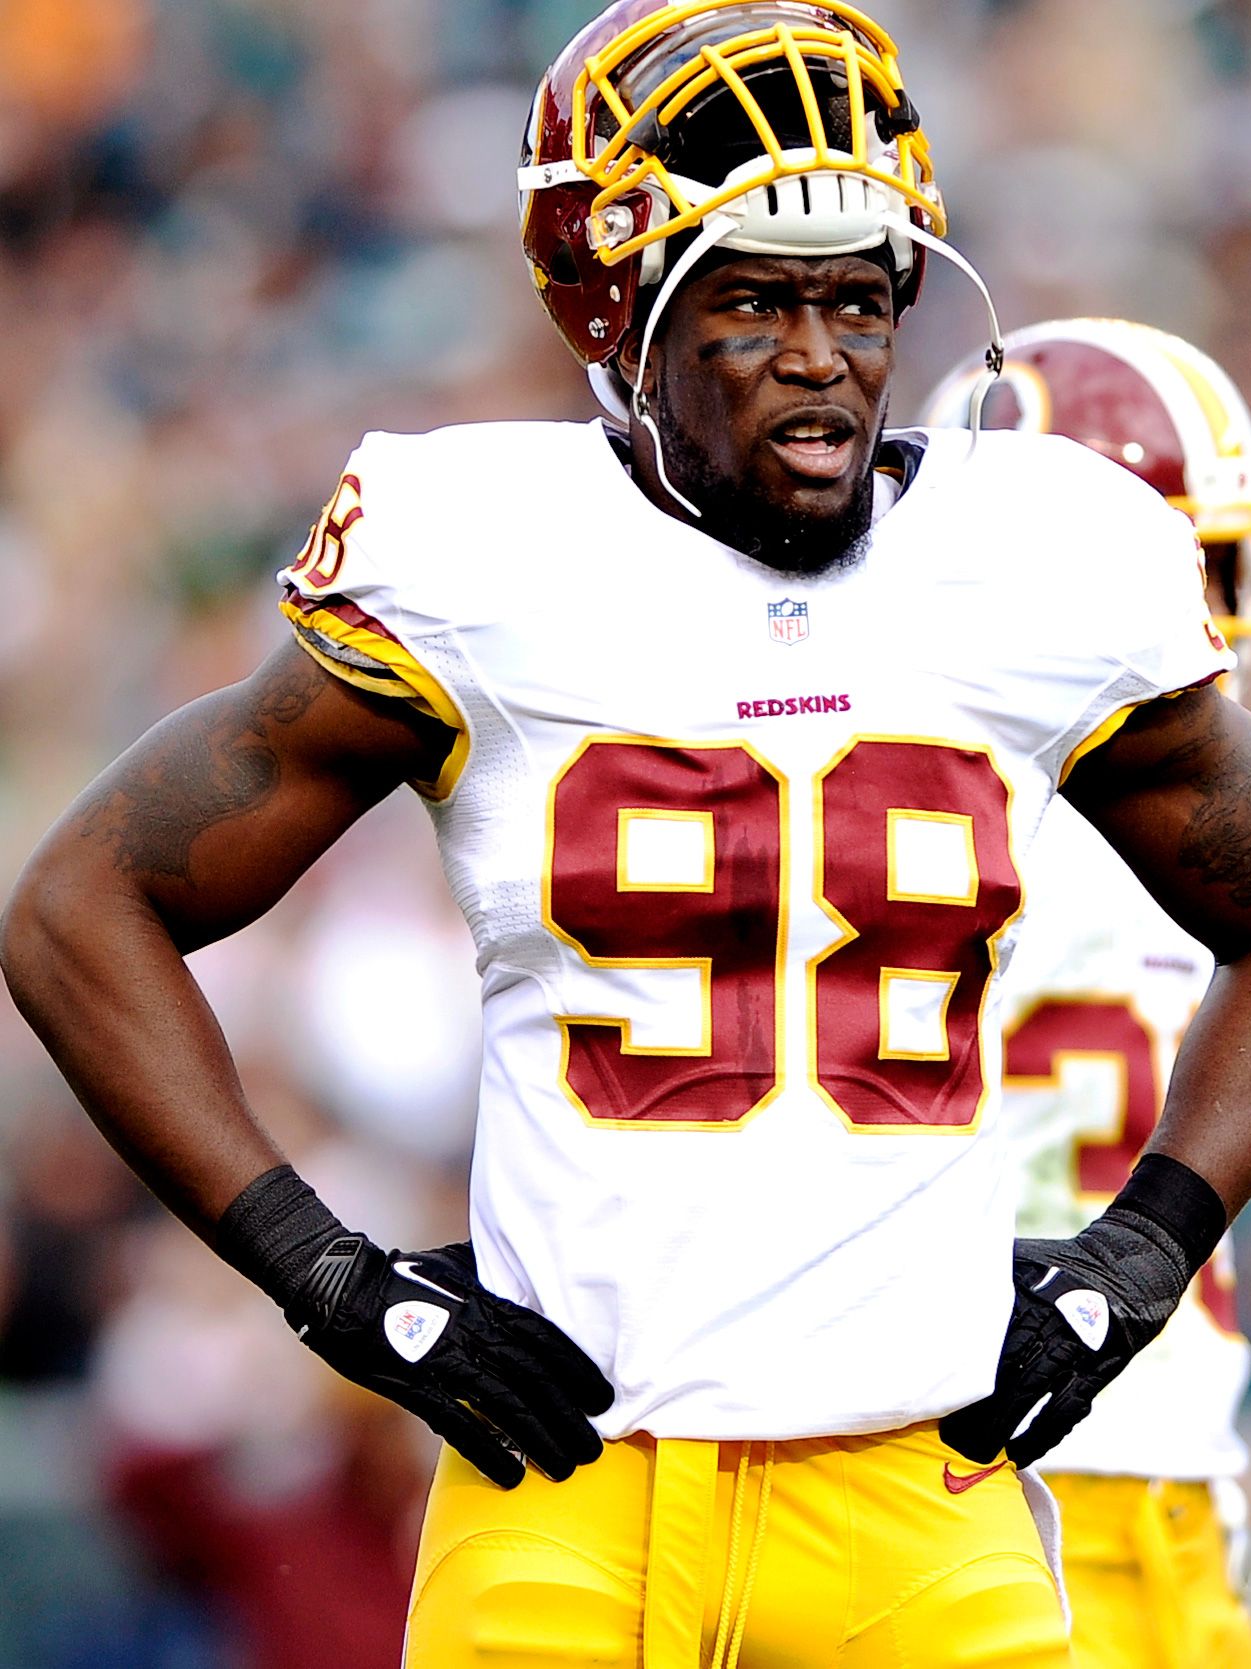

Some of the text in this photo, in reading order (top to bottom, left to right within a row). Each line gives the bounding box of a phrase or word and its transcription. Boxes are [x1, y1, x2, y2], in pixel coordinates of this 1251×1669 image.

[772, 618, 806, 640] NFL
[736, 694, 852, 719] REDSKINS
[541, 733, 1026, 1135] 98
